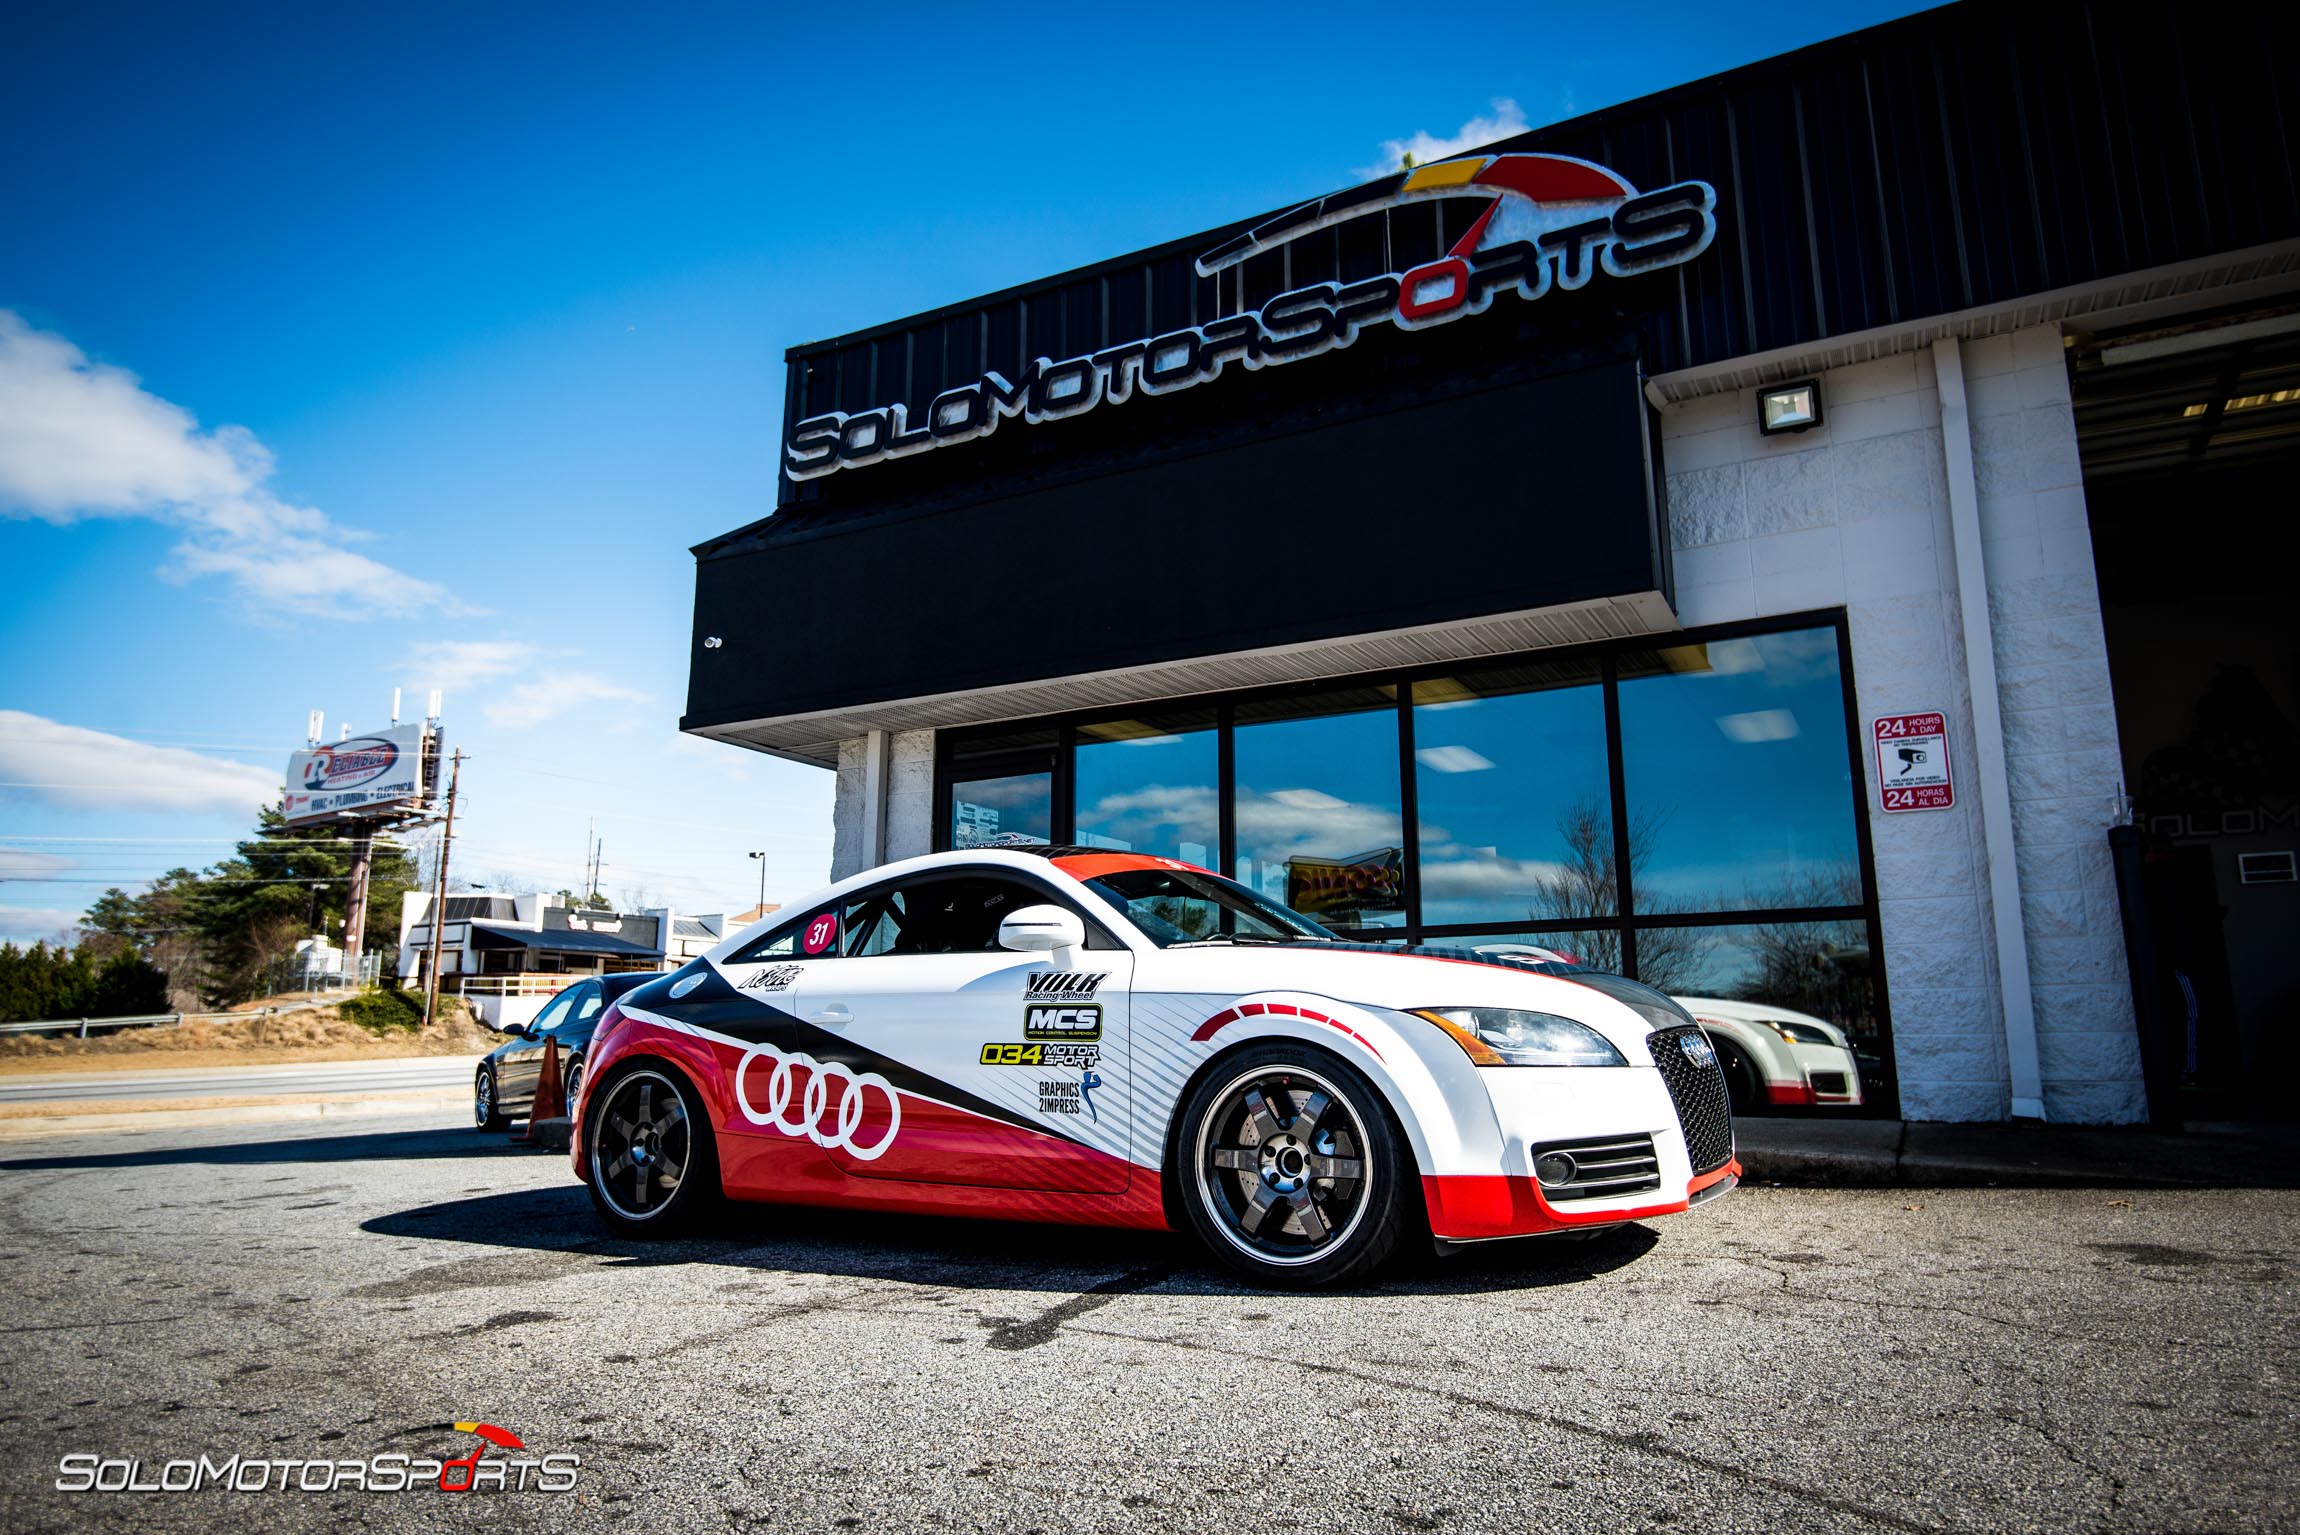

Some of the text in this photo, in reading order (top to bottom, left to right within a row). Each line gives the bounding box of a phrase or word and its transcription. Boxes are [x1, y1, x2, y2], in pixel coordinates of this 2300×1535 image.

[1878, 716, 1941, 737] 24 HOURS
[1920, 725, 1936, 733] DAY
[327, 772, 358, 785] HEATING
[312, 799, 328, 811] HVAC
[335, 792, 368, 806] PLUMBING
[1887, 788, 1944, 807] 24 HORAS
[1933, 796, 1949, 805] DIA
[809, 922, 829, 945] 31
[1025, 990, 1094, 1001] Racing Wheel
[1028, 1009, 1098, 1030] MCS
[981, 1044, 1042, 1065] 034
[1044, 1045, 1097, 1055] MOTOR
[1043, 1056, 1096, 1068] SPORT
[1039, 1081, 1080, 1098] GRAPHICS
[1039, 1097, 1080, 1114] 2IMPRESS
